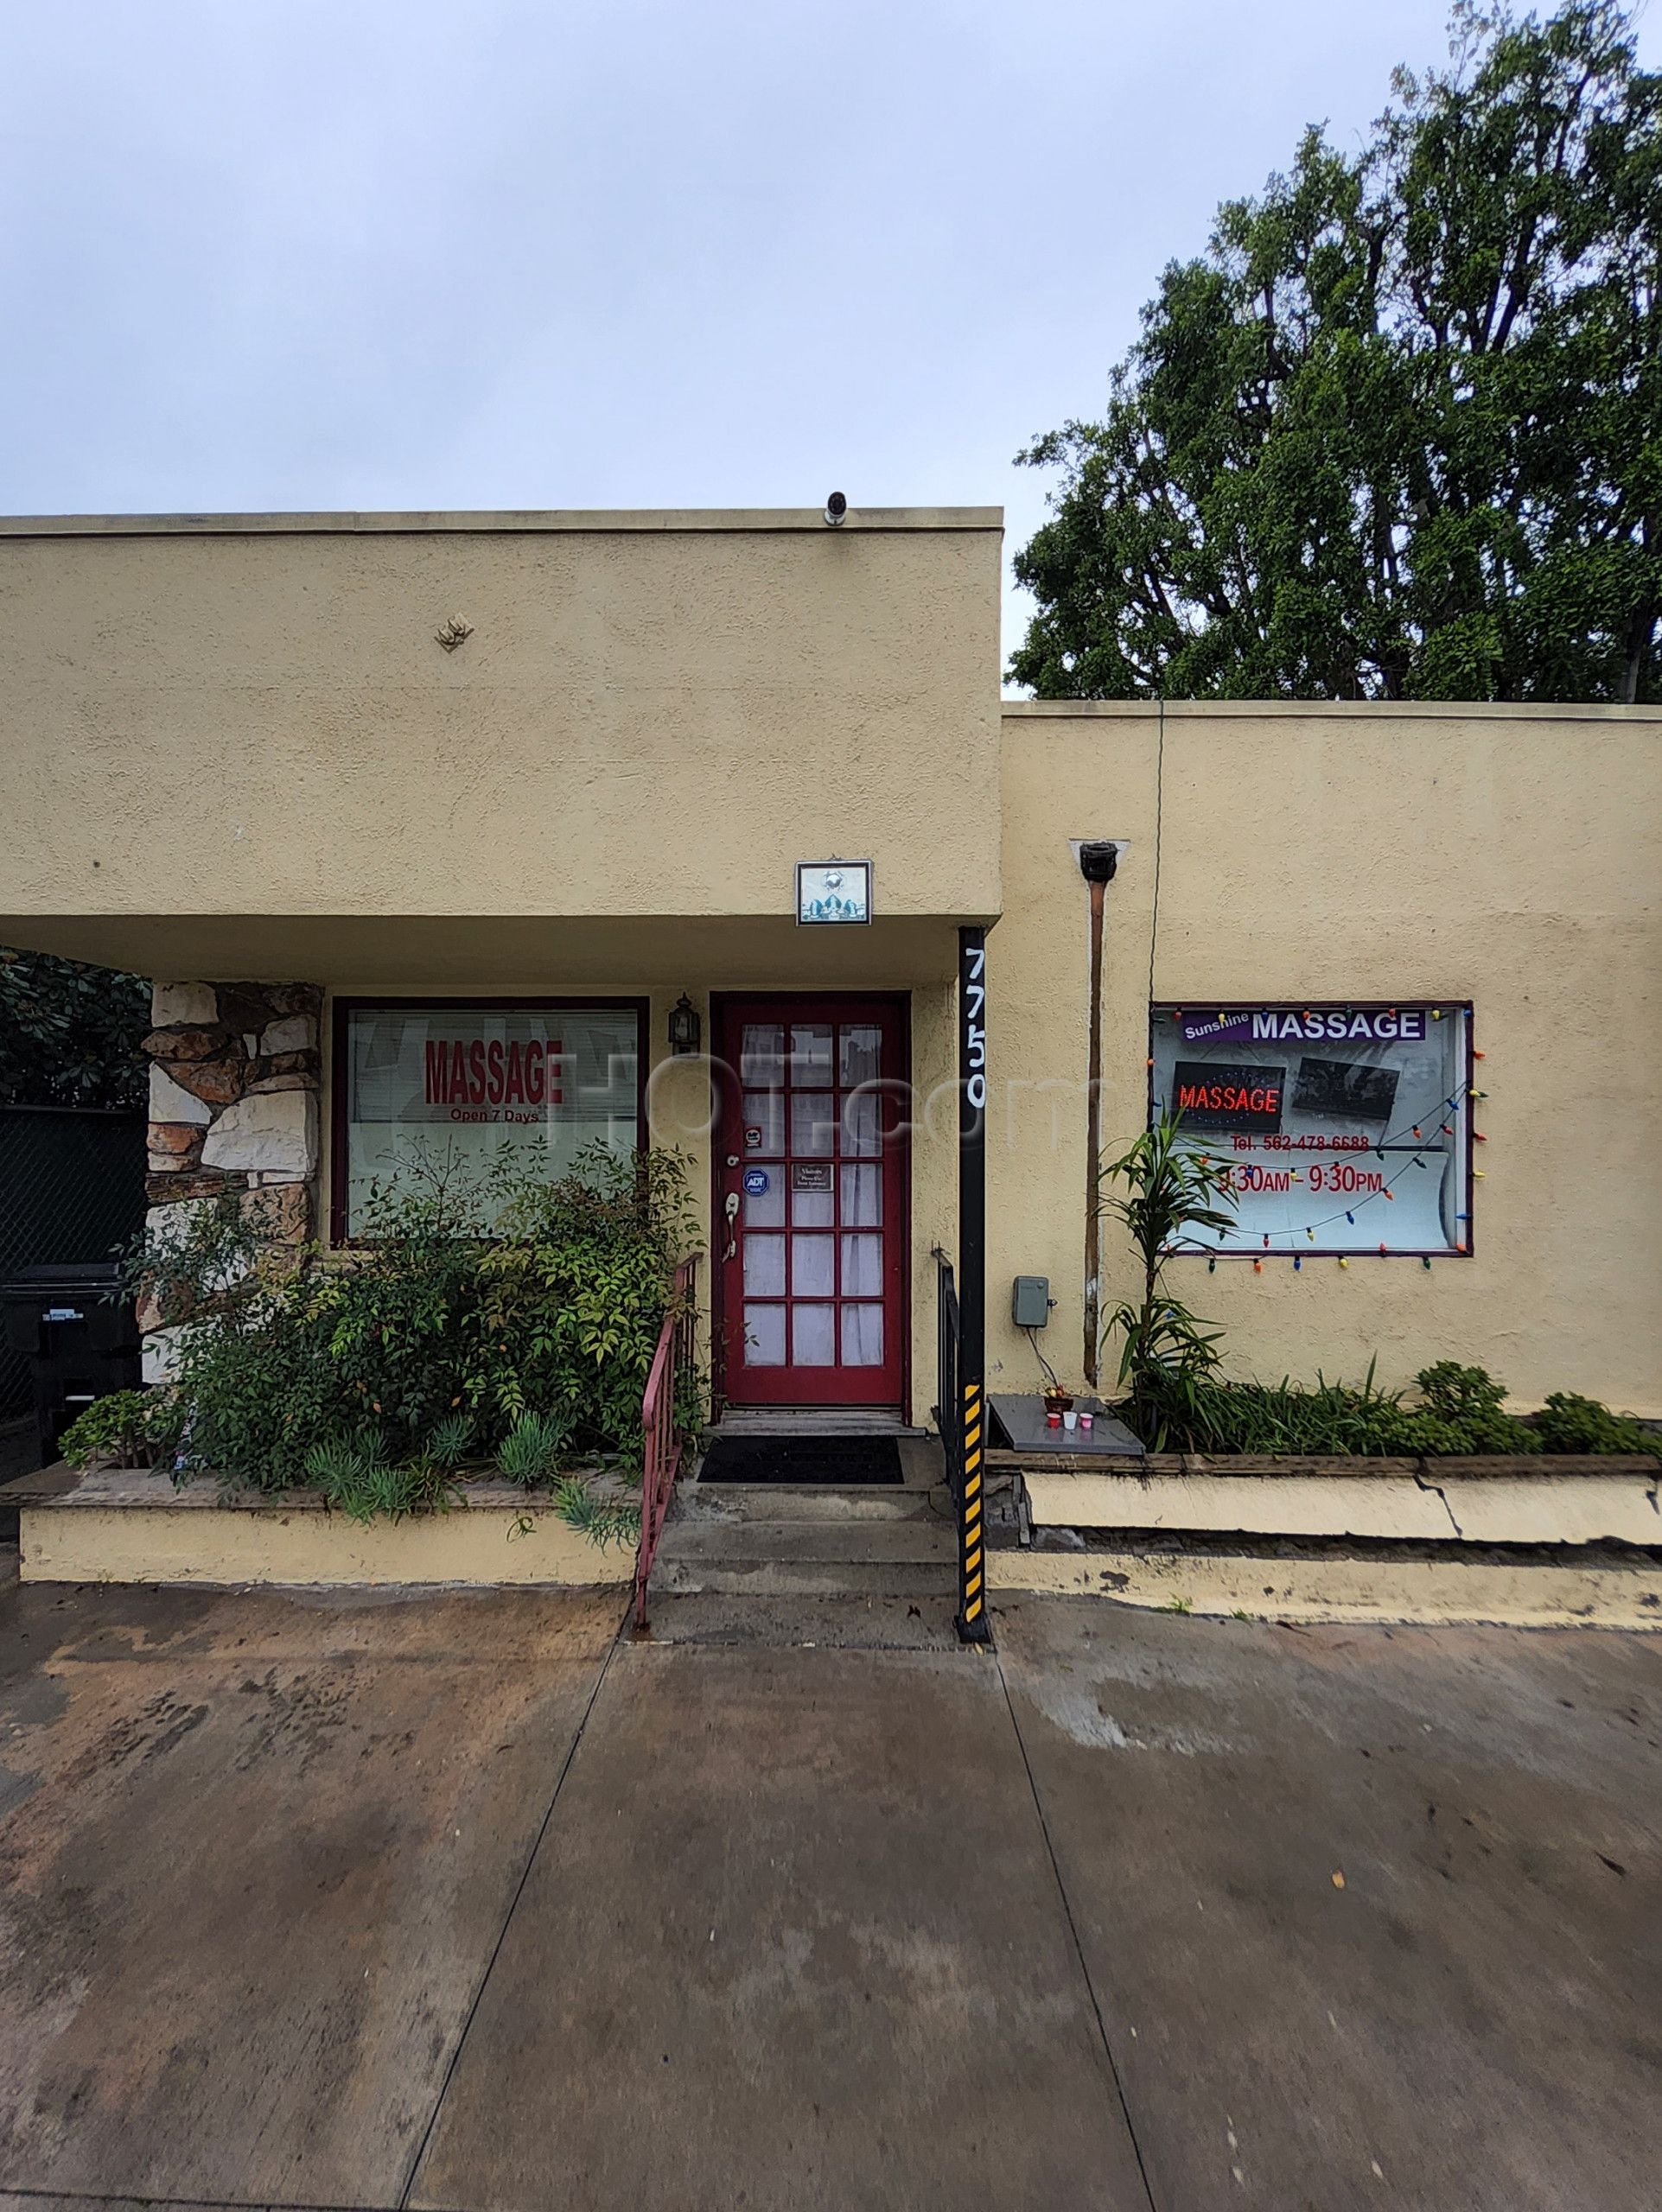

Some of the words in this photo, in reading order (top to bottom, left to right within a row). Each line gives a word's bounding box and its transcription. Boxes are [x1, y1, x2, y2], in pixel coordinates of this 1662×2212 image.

[965, 948, 986, 1108] 7750
[1185, 1012, 1249, 1039] Sunshine
[1252, 1013, 1420, 1039] MASSAGE
[424, 1039, 564, 1105] MASSAGE
[1179, 1084, 1280, 1113] MASSAGE
[450, 1108, 488, 1123] Open
[492, 1109, 501, 1122] 7
[504, 1109, 540, 1125] Days
[1230, 1135, 1257, 1152] Tel.
[747, 1177, 765, 1187] ADT
[1309, 1166, 1384, 1192] 9:30PM
